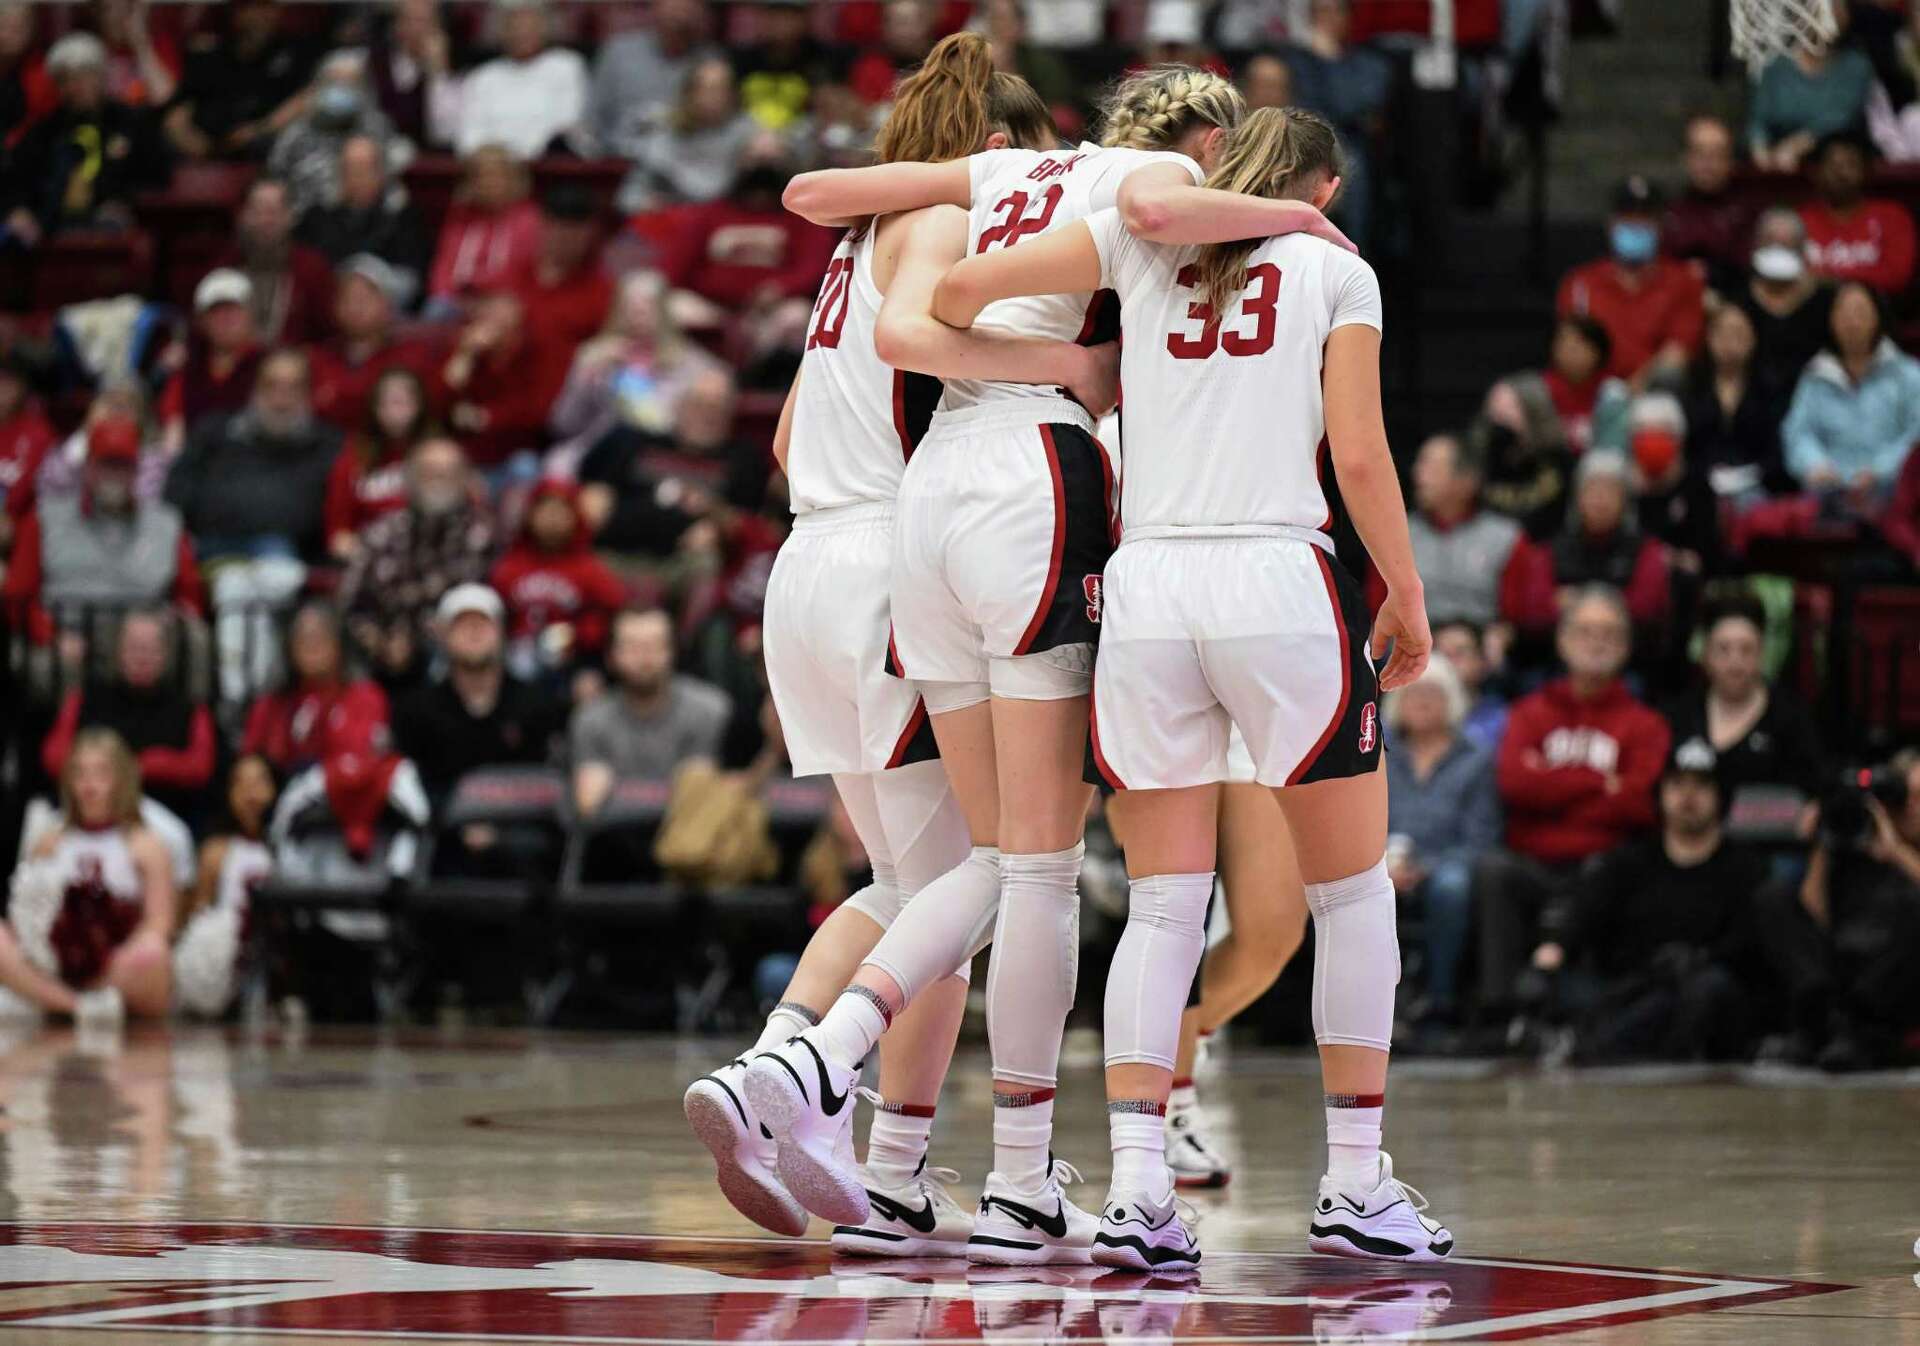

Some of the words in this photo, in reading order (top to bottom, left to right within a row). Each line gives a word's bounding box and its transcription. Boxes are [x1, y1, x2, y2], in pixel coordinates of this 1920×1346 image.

[976, 183, 1064, 255] 22
[1166, 262, 1282, 360] 33
[1358, 701, 1377, 754] S
